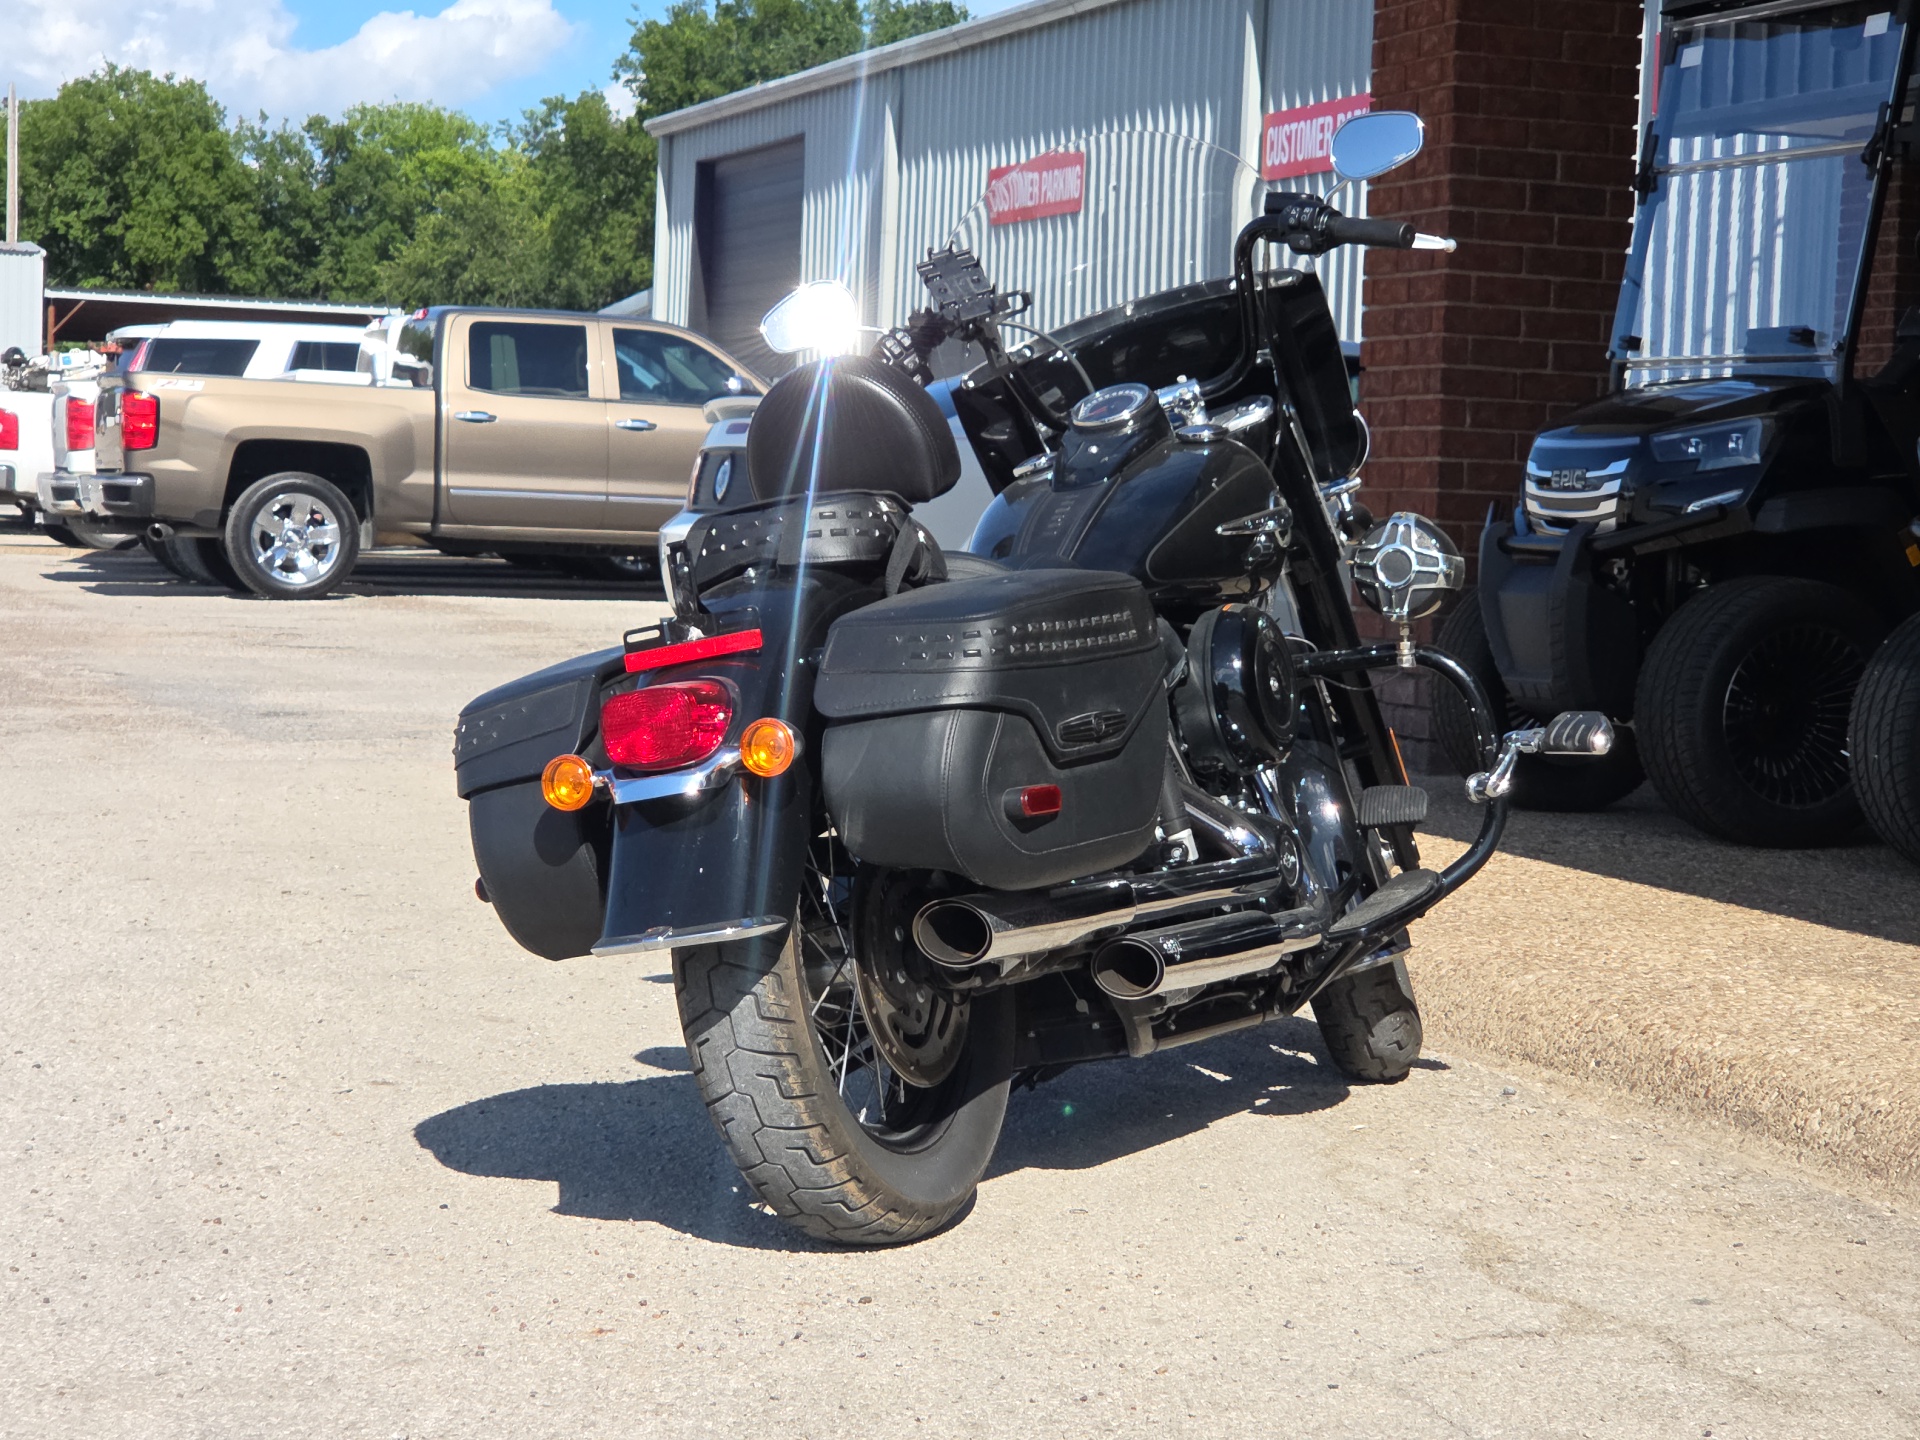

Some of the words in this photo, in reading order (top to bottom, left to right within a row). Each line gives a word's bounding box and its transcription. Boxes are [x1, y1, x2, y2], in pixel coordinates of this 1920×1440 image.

[1266, 115, 1334, 167] CUSTOMER
[988, 169, 1039, 213] CUSTOMER
[1040, 164, 1081, 204] PARKING
[1551, 468, 1586, 489] EPIC
